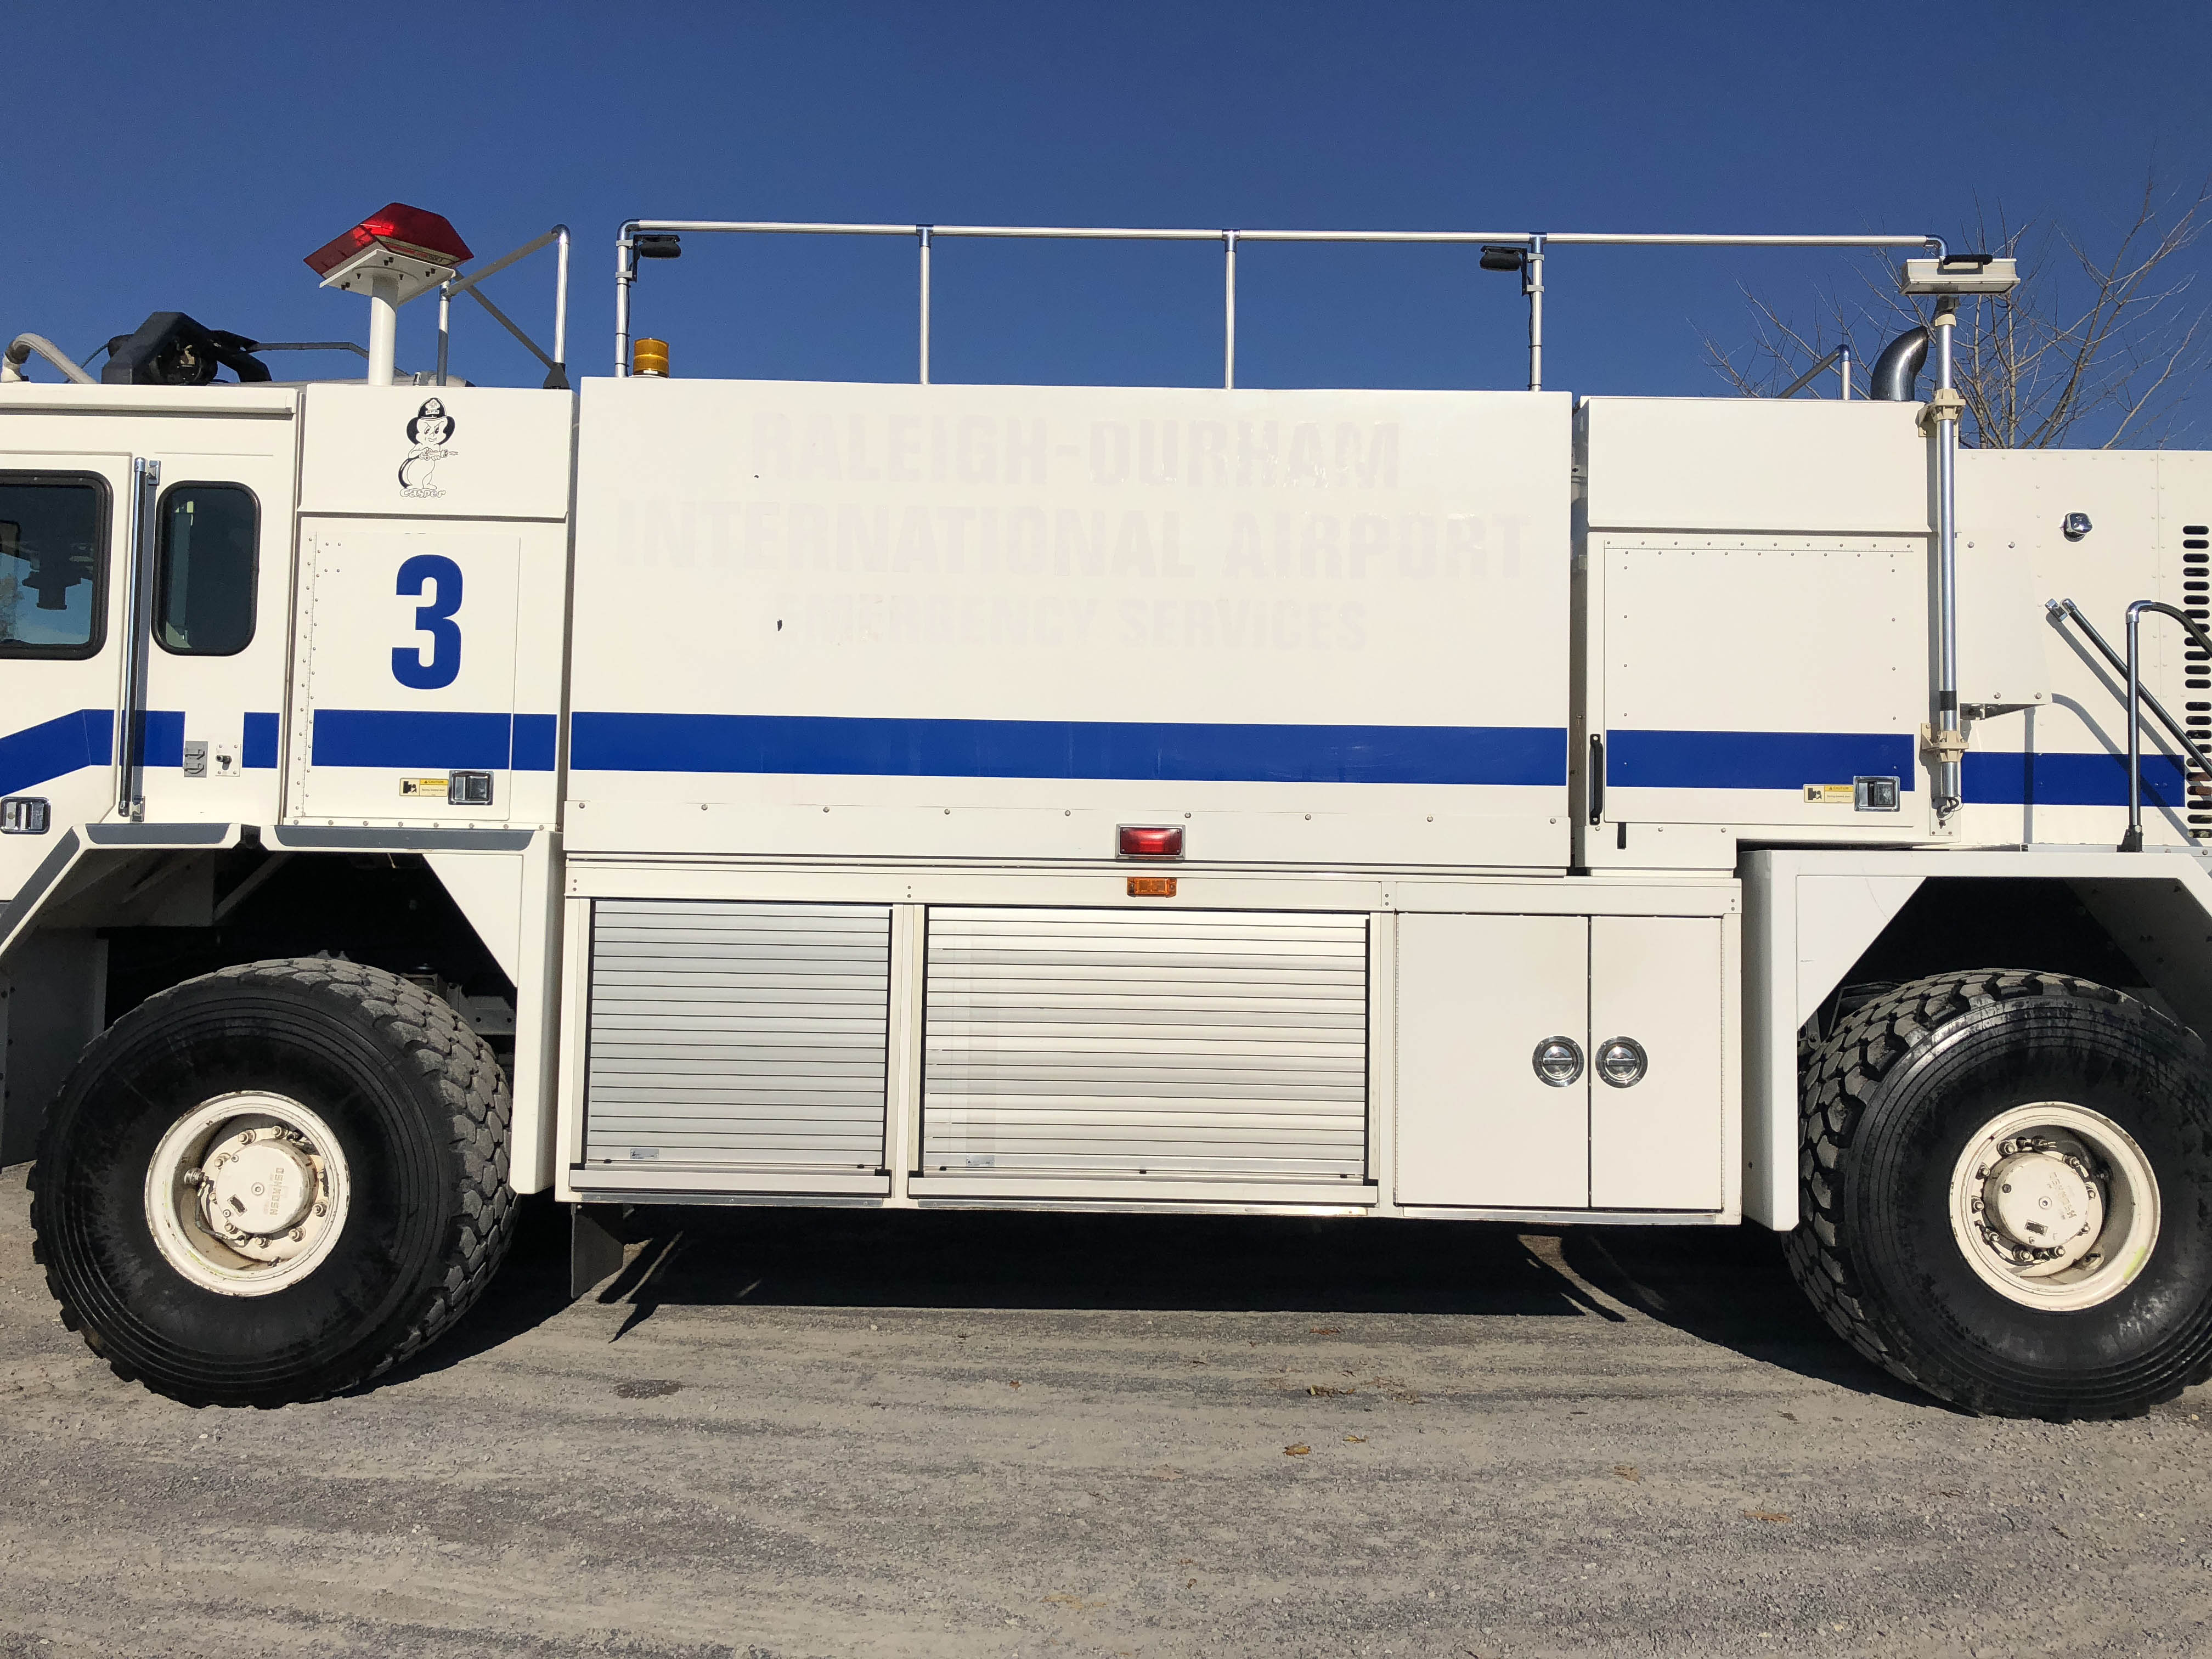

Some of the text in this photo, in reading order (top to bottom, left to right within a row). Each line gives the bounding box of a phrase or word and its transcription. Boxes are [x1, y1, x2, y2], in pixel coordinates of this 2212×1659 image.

[752, 411, 1400, 490] RALEIGH-DURHAM
[399, 488, 447, 498] Casper
[613, 499, 1531, 580] INTERNATIONAL AIRPORT
[391, 554, 463, 690] 3
[776, 591, 1367, 651] EMERGENCY SERVICES
